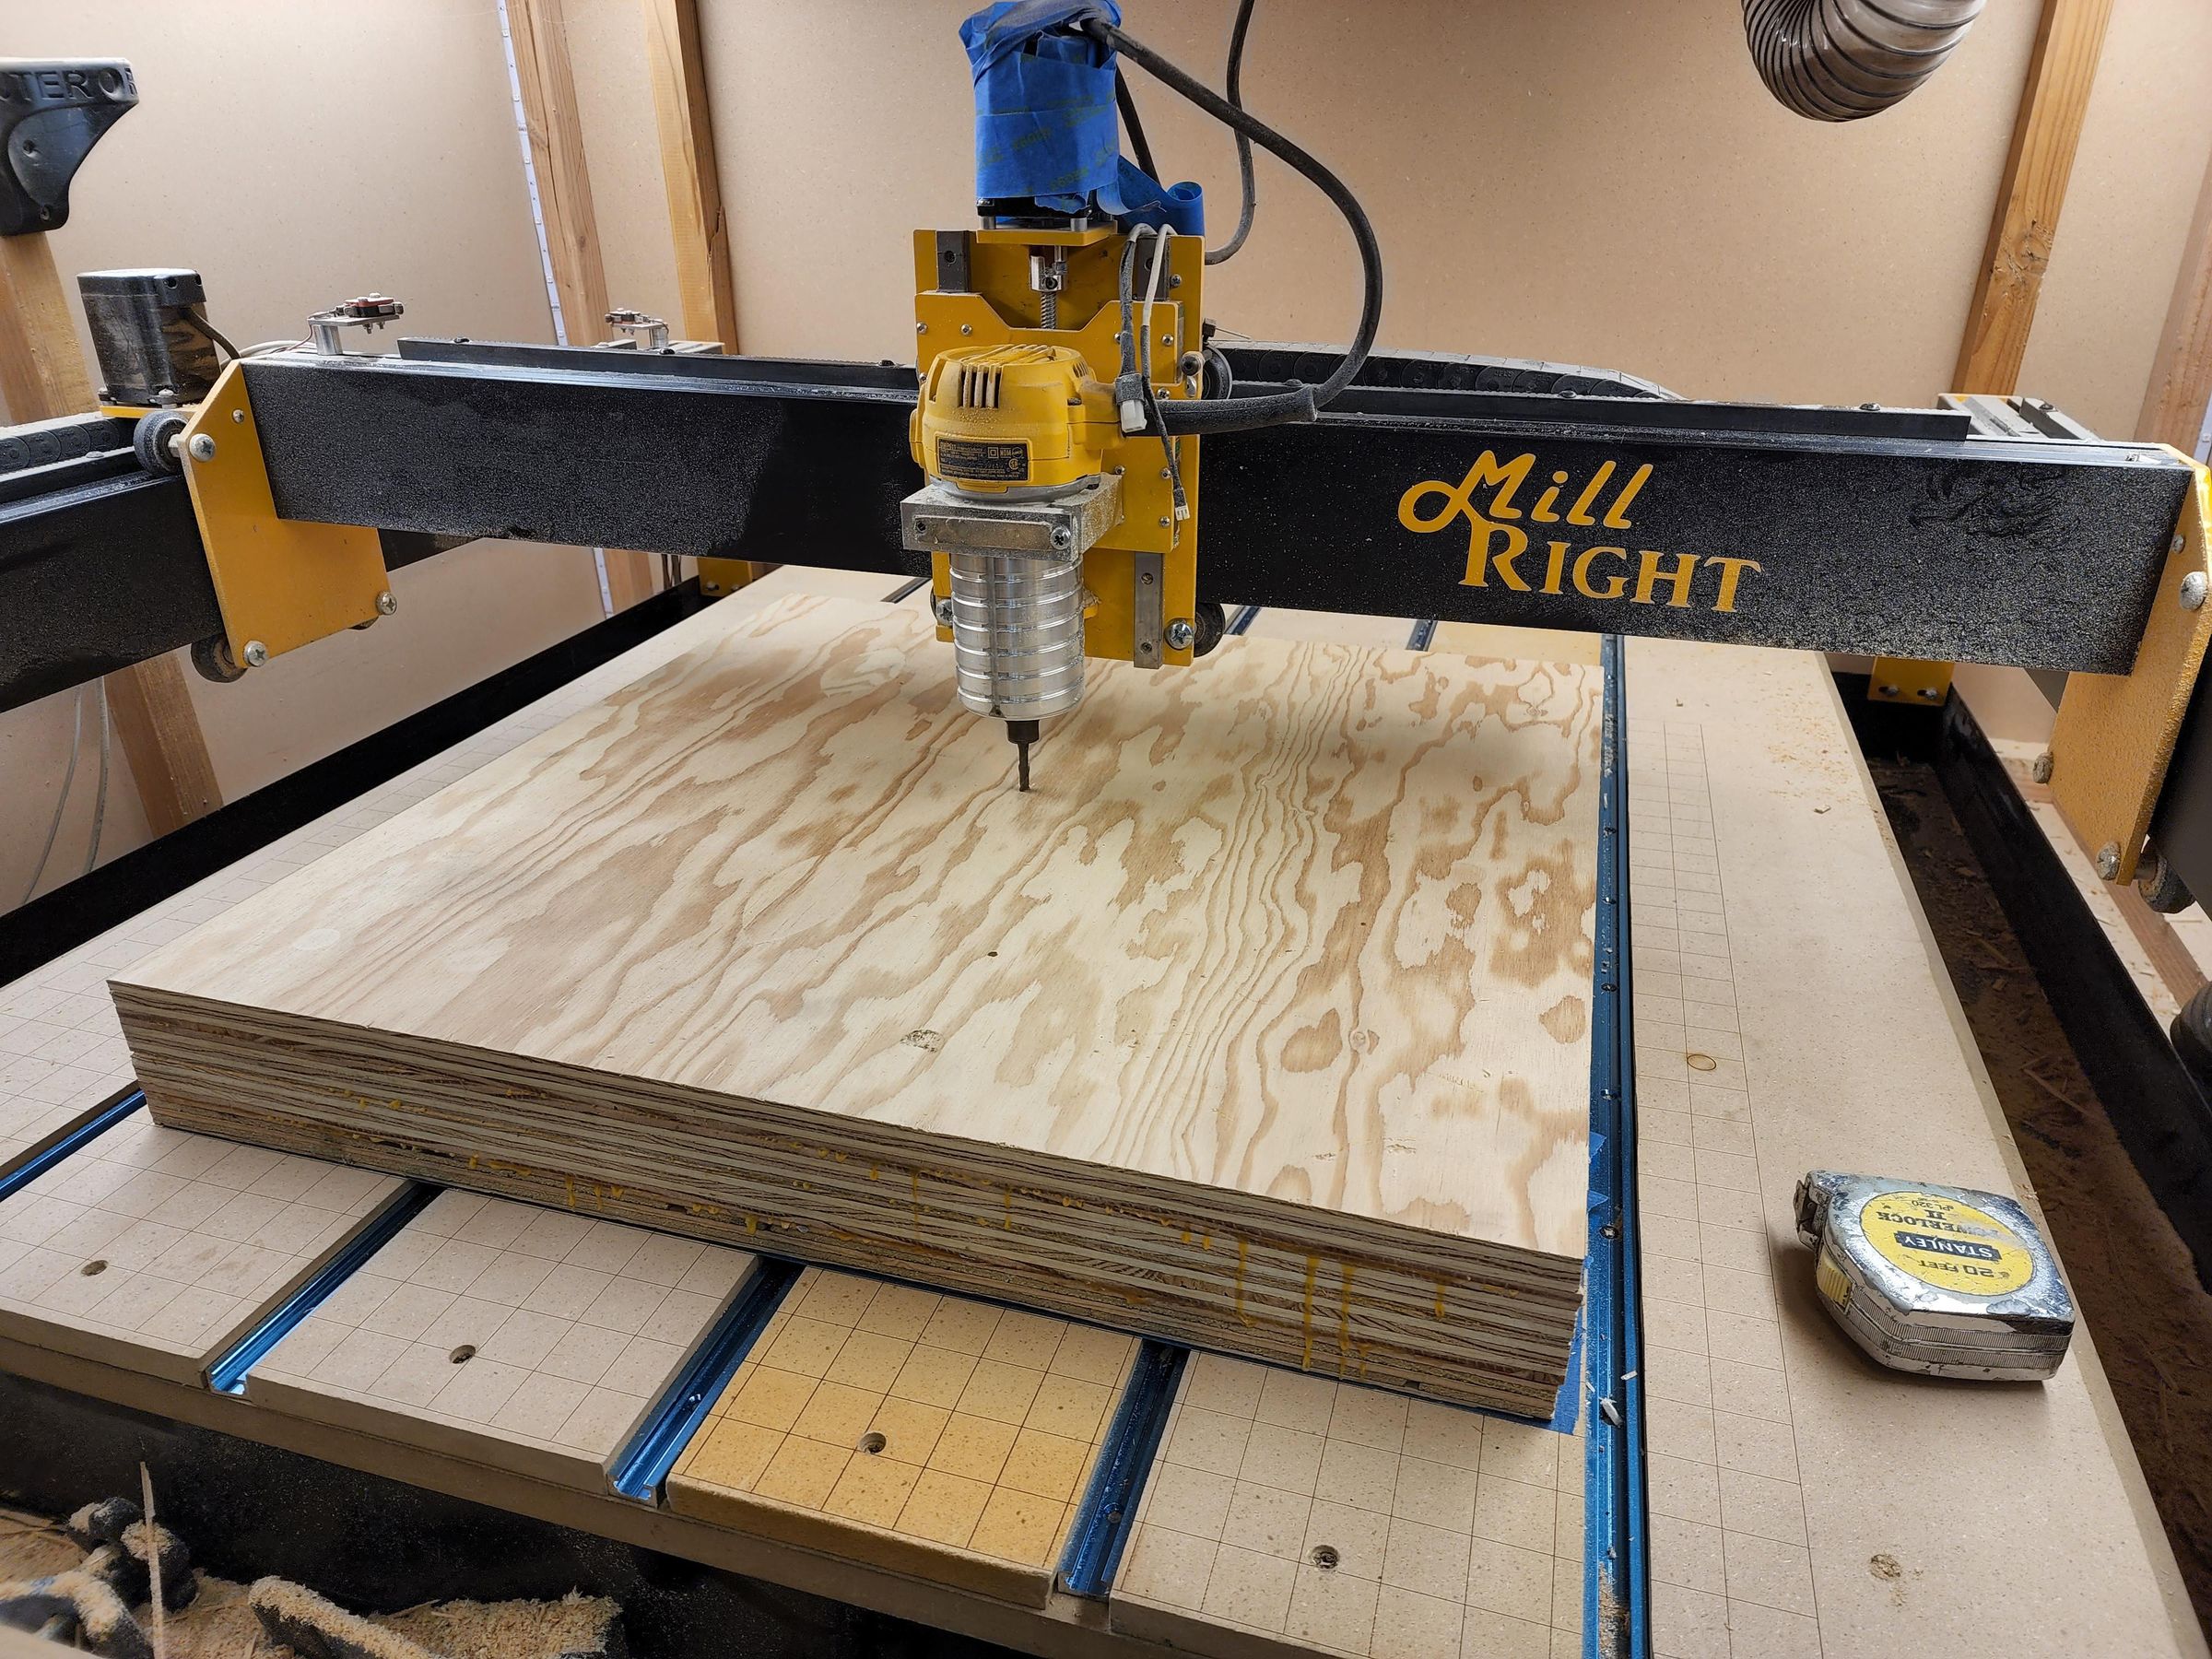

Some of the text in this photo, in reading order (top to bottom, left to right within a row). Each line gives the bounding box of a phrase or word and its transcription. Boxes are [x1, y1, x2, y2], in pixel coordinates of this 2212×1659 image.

[1397, 449, 1654, 533] Mill
[1457, 521, 1767, 613] RIGHT
[1912, 1200, 1935, 1208] 320
[1876, 1211, 1998, 1236] WERLOCK
[1904, 1235, 1994, 1258] STANLEY
[1918, 1259, 1995, 1278] 20 FEET
